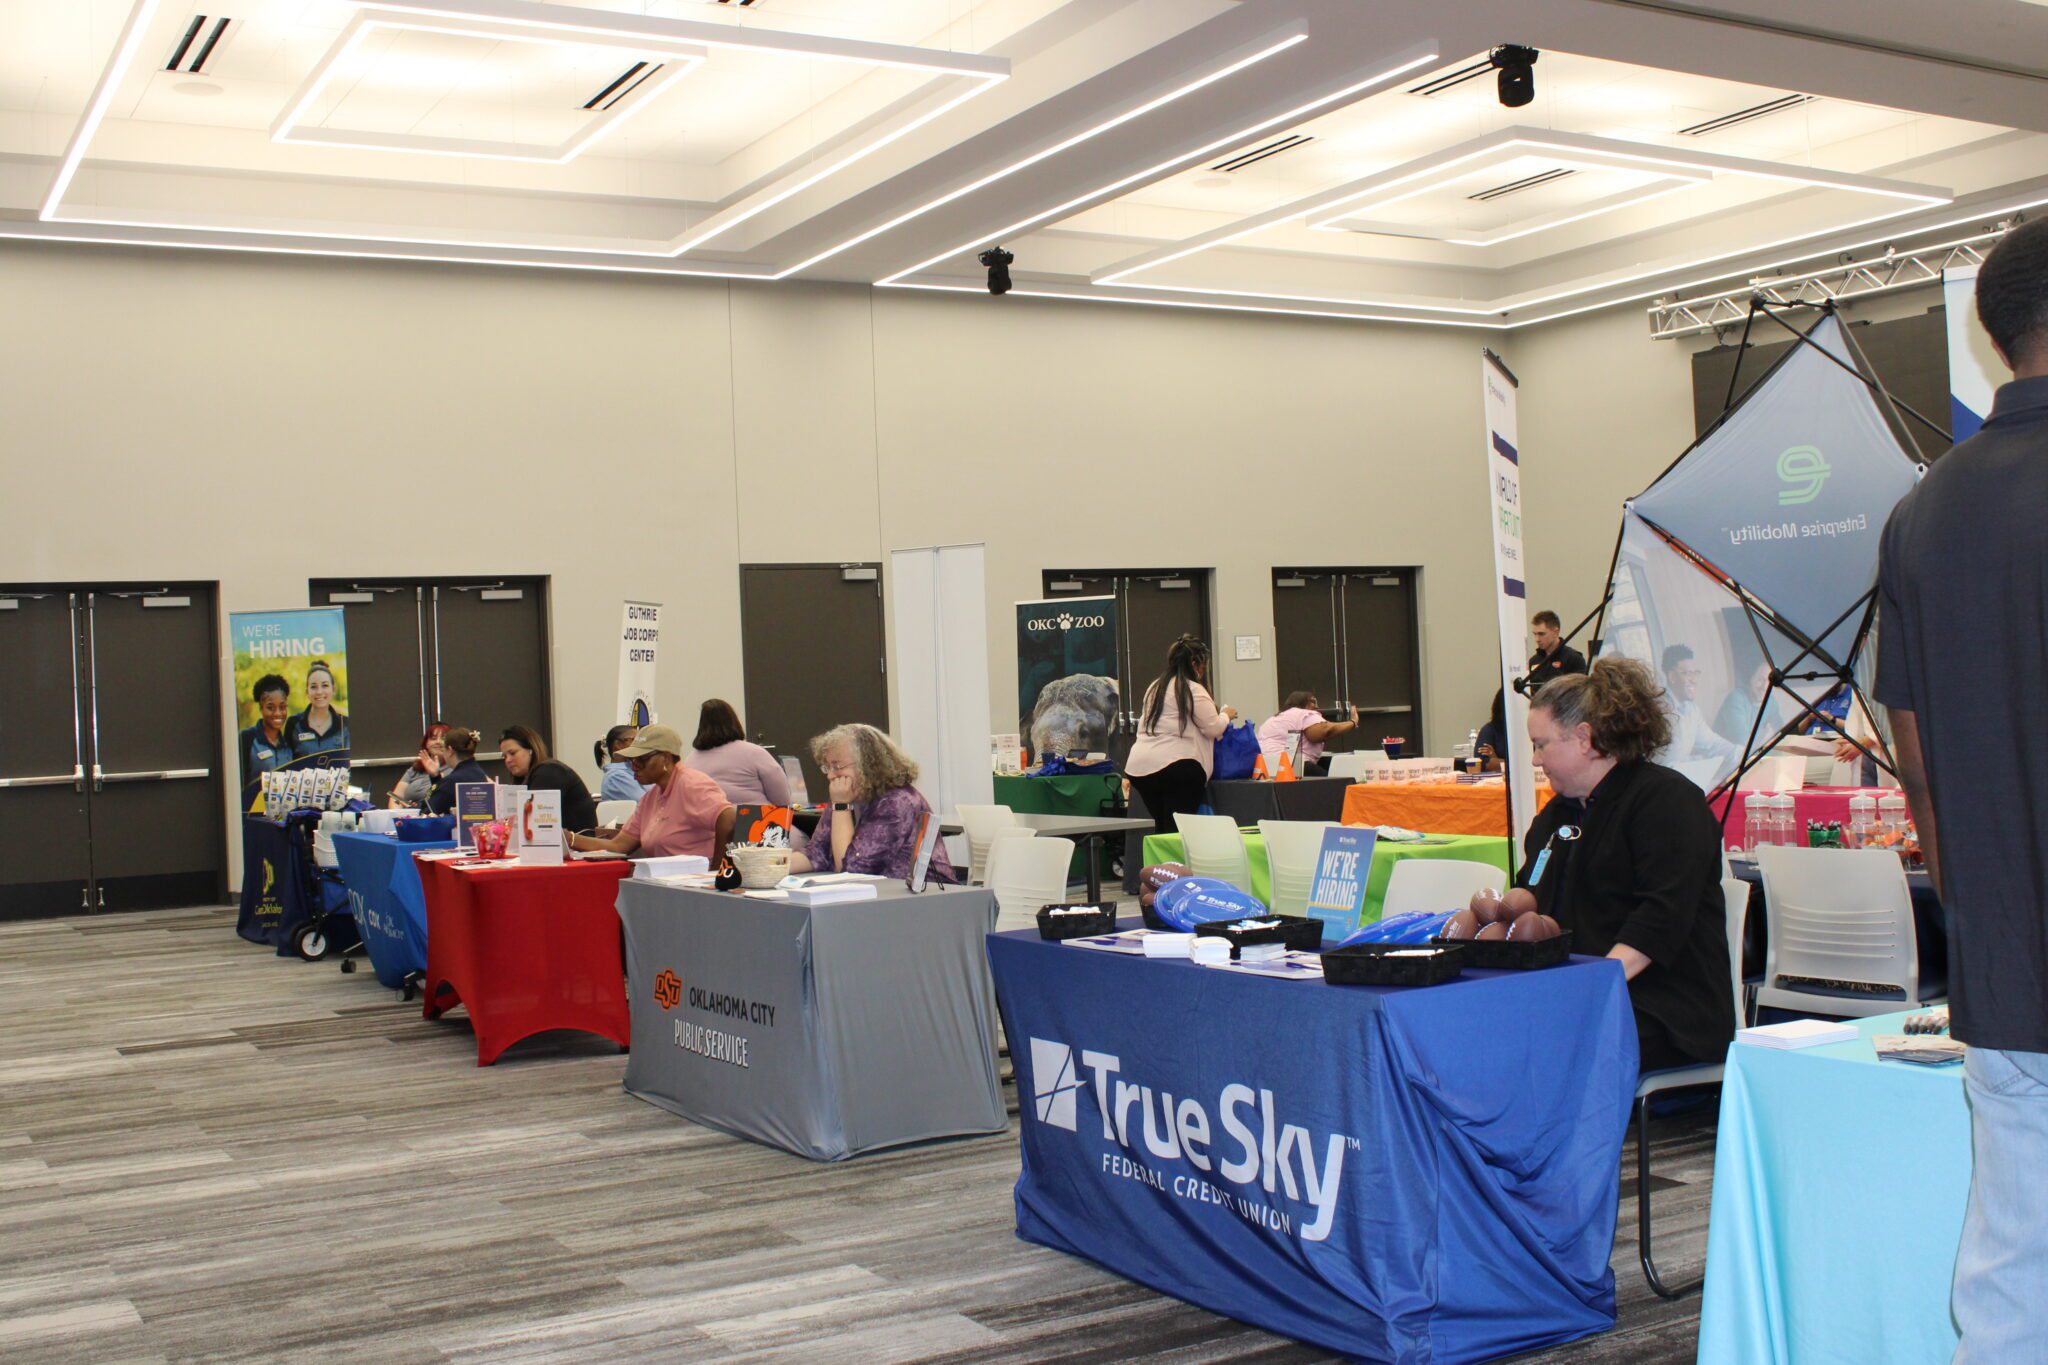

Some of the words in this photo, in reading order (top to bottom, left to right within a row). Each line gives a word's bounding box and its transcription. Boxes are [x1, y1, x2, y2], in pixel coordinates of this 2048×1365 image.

[628, 606, 657, 621] GUTHRIE
[1027, 618, 1057, 631] OKC
[1074, 615, 1105, 629] ZOO
[242, 623, 281, 638] WE'RE
[624, 627, 638, 641] JOB
[249, 636, 326, 659] HIRING
[629, 649, 655, 662] CENTER
[1321, 849, 1360, 880] WE'RE
[1316, 879, 1358, 909] HIRING
[689, 986, 749, 1022] OKLAHOMA
[750, 1002, 776, 1028] CITY
[674, 1018, 703, 1055] PUBLIC
[704, 1028, 749, 1069] SERVICE
[1082, 1049, 1212, 1171] True
[1219, 1083, 1346, 1242] Sky
[1102, 1152, 1166, 1192] FEDERAL
[1173, 1175, 1235, 1210] CREDIT
[1238, 1197, 1292, 1236] UNION
